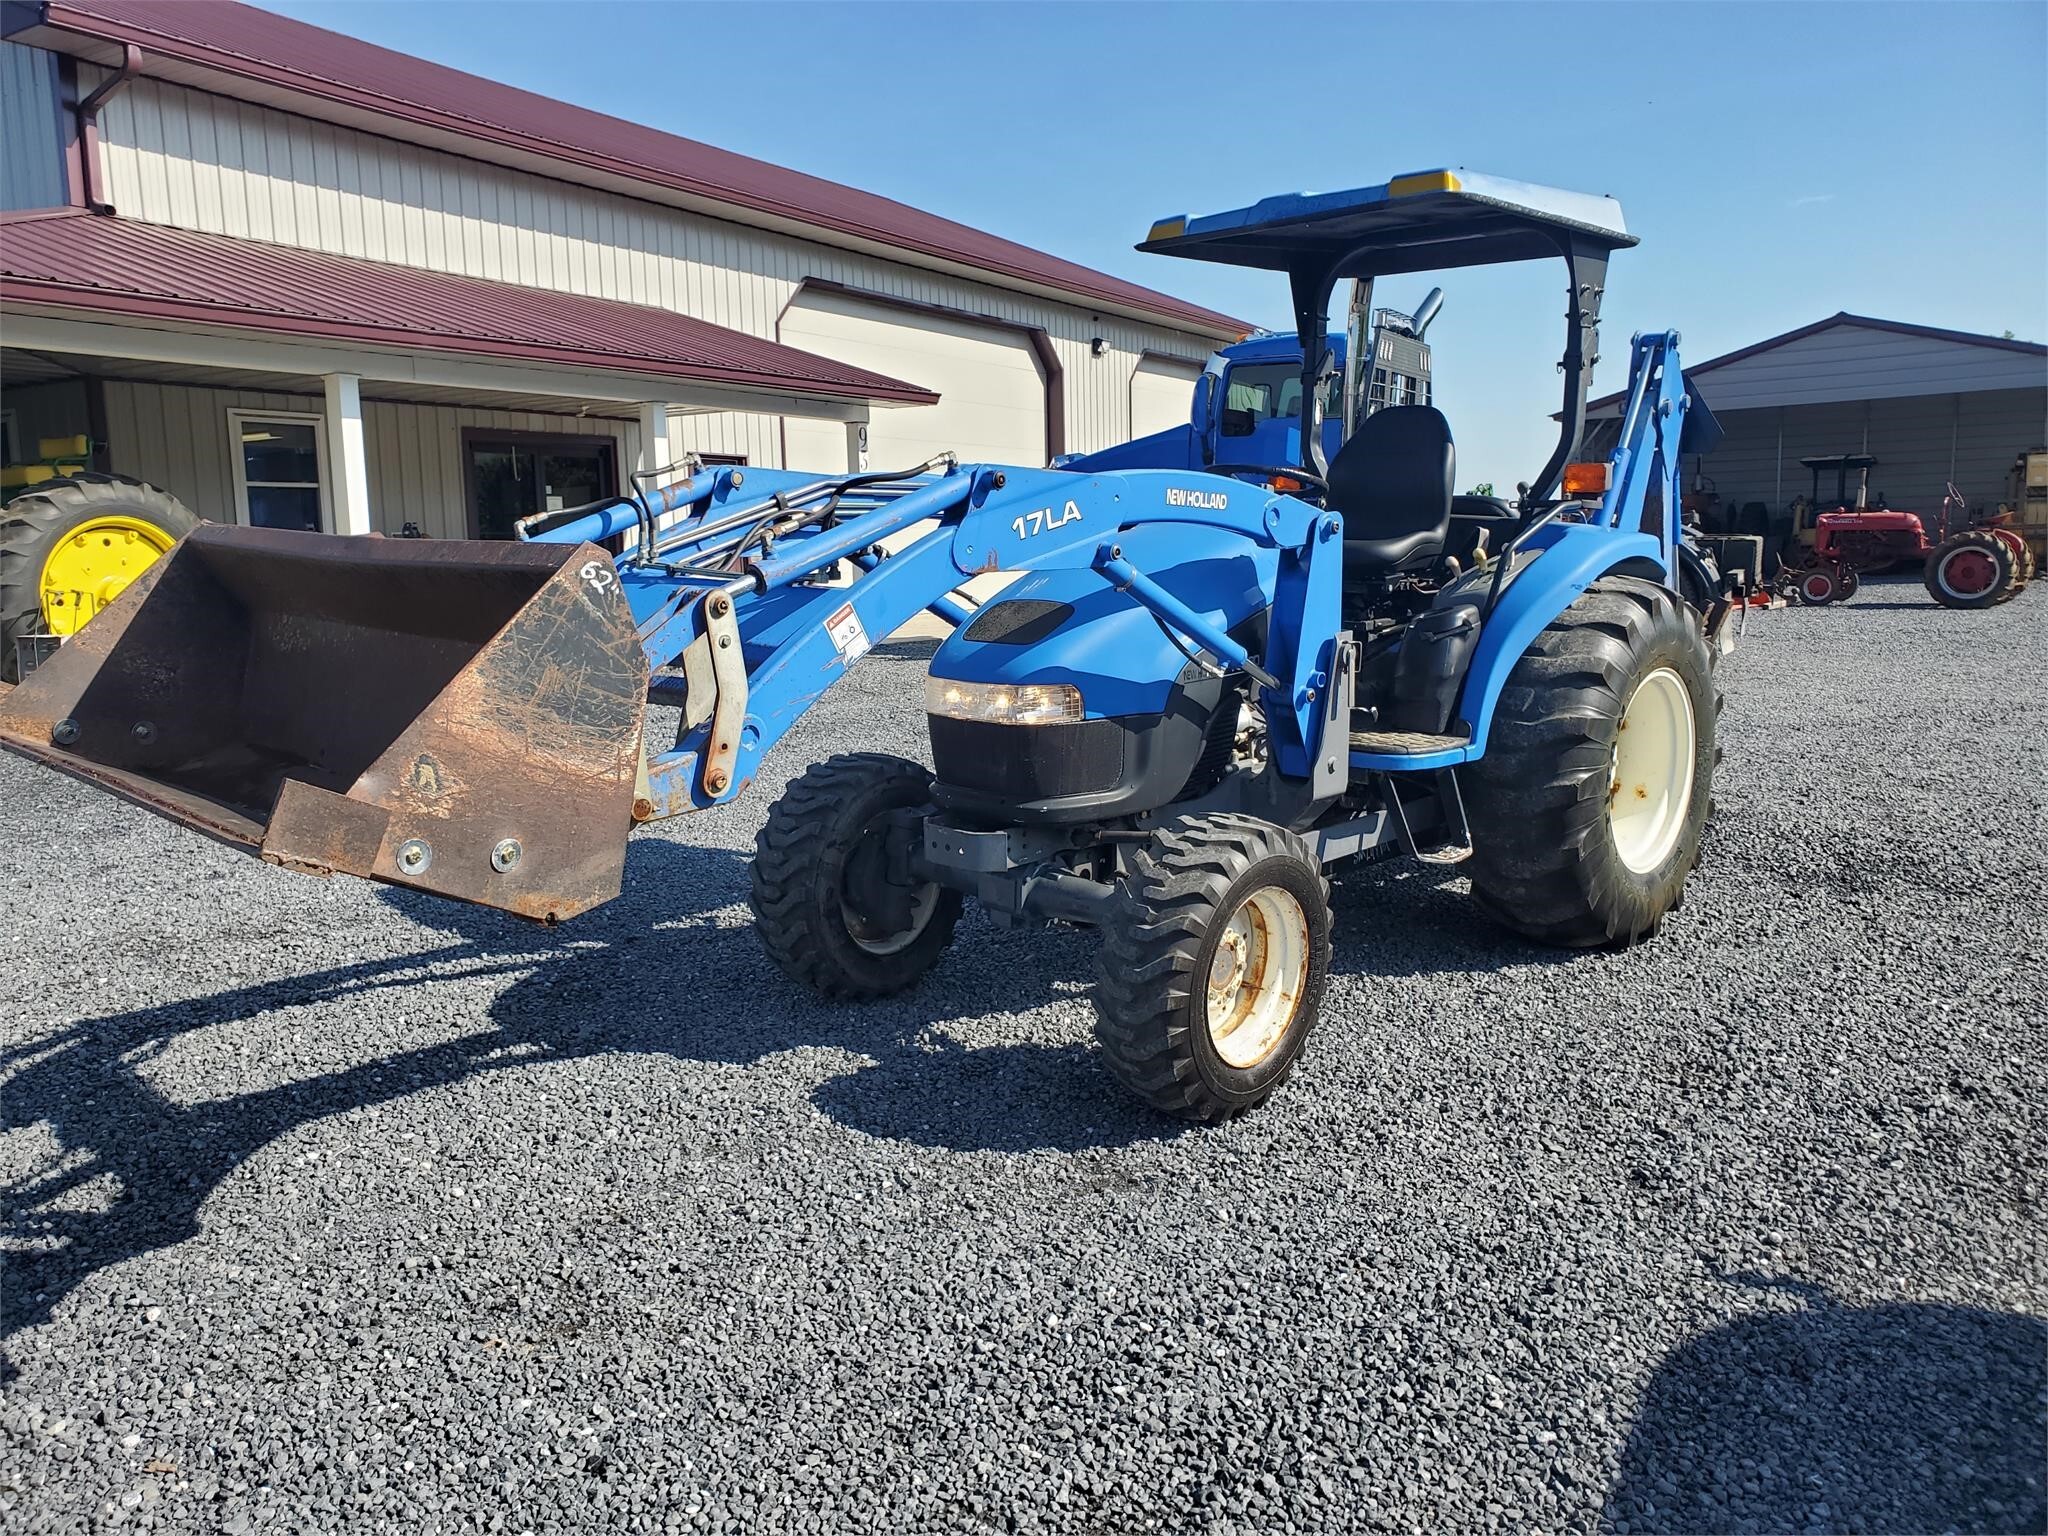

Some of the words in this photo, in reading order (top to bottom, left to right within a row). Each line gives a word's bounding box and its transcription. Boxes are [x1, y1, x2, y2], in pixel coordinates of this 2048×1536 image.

[1166, 488, 1186, 506] NEW
[1187, 491, 1228, 510] HOLLAND
[1011, 500, 1083, 540] 17LA
